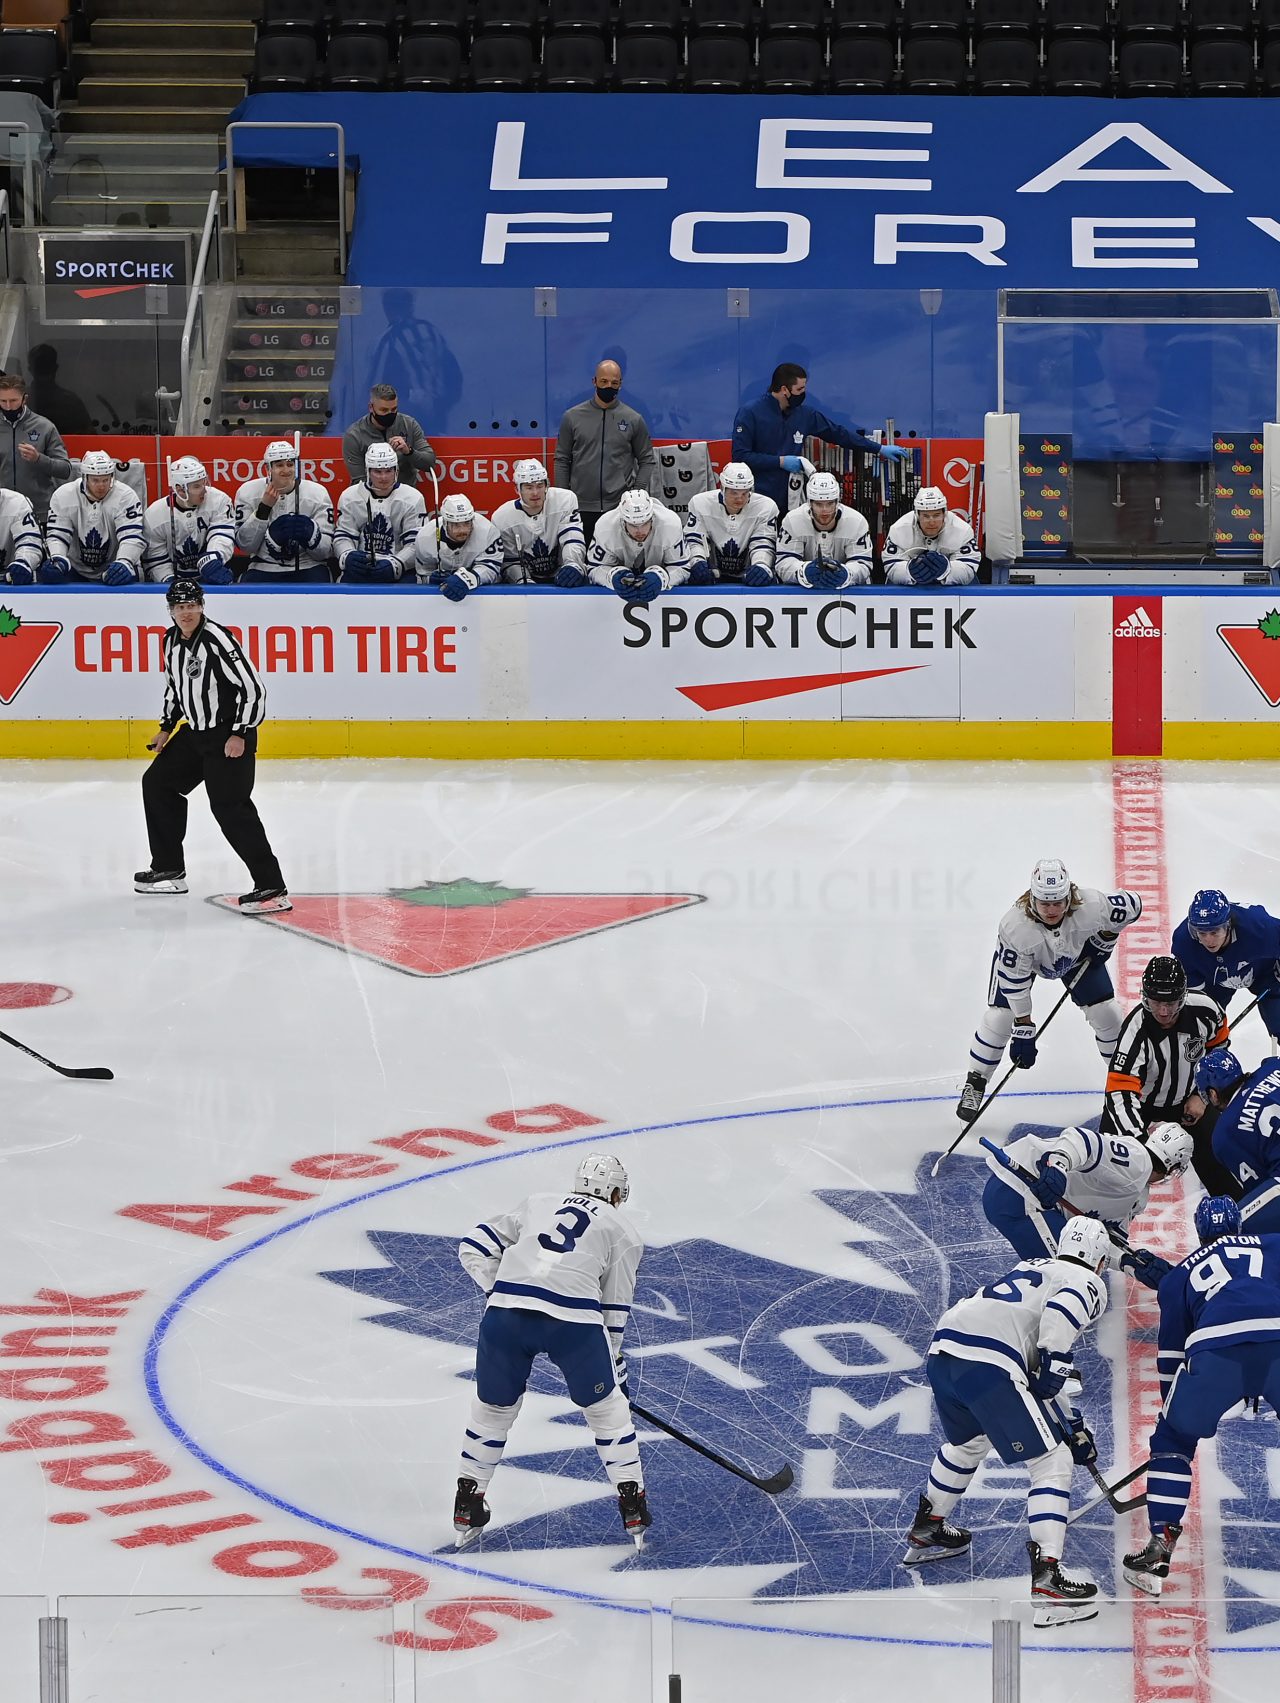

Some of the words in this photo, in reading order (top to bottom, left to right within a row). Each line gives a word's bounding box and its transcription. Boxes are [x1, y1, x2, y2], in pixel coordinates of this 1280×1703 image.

[270, 305, 285, 314] LG
[320, 305, 335, 314] LG
[264, 335, 279, 345] LG
[315, 335, 330, 345] LG
[259, 366, 274, 377] LG
[310, 366, 325, 377] LG
[253, 400, 268, 409] LG
[305, 400, 320, 409] LG
[213, 457, 335, 483] ROGRS
[623, 600, 977, 649] SPORTCHEK
[1114, 622, 1161, 639] adidas
[347, 625, 457, 673] TIRE
[1046, 877, 1056, 886] 88
[1107, 894, 1127, 924] 88
[1110, 1143, 1130, 1168] 91
[116, 1103, 608, 1241] Arena
[583, 1177, 589, 1187] 3
[562, 1196, 599, 1216] HOLL
[1211, 1213, 1224, 1224] 97
[537, 1206, 591, 1254] 3
[1181, 1235, 1262, 1270] THORNTON
[1189, 1246, 1264, 1301] 97
[0, 1288, 554, 1652] Scotiabank
